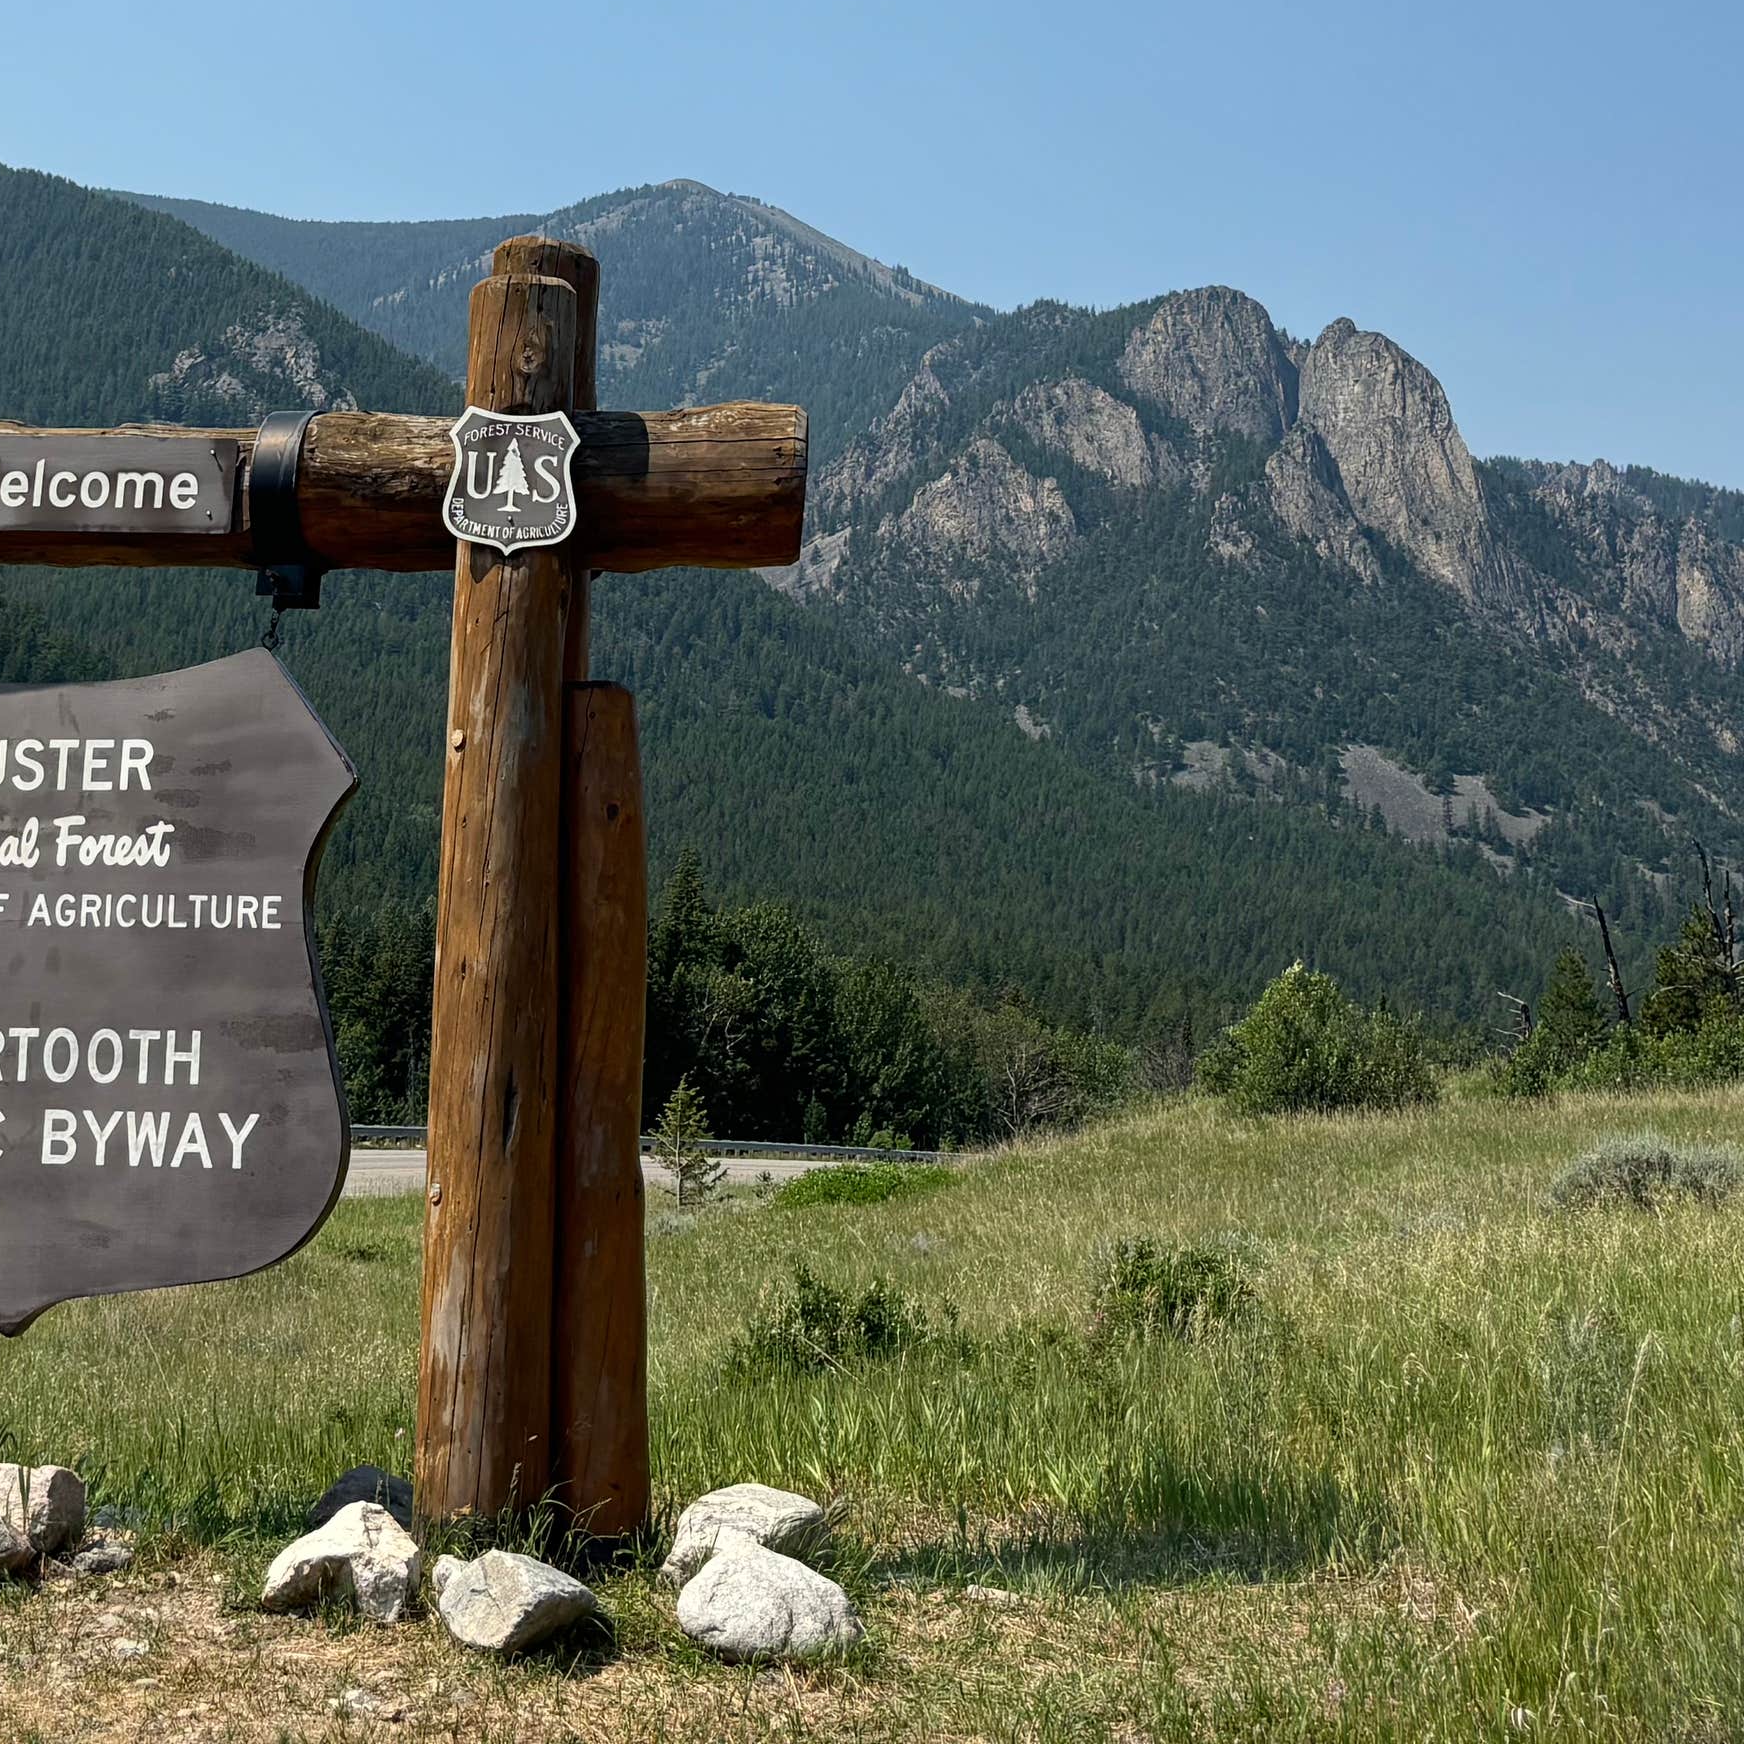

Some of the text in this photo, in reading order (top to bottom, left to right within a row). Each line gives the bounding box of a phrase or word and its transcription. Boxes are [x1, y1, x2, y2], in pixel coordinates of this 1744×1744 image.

[464, 423, 565, 451] FOREST SERVICE
[466, 451, 561, 503] U S
[451, 497, 568, 539] DEPARTMENT OF AGRICULTURE
[52, 815, 175, 868] Forest
[27, 893, 282, 929] AGRICULTURE
[41, 1108, 260, 1170] BYWAY
